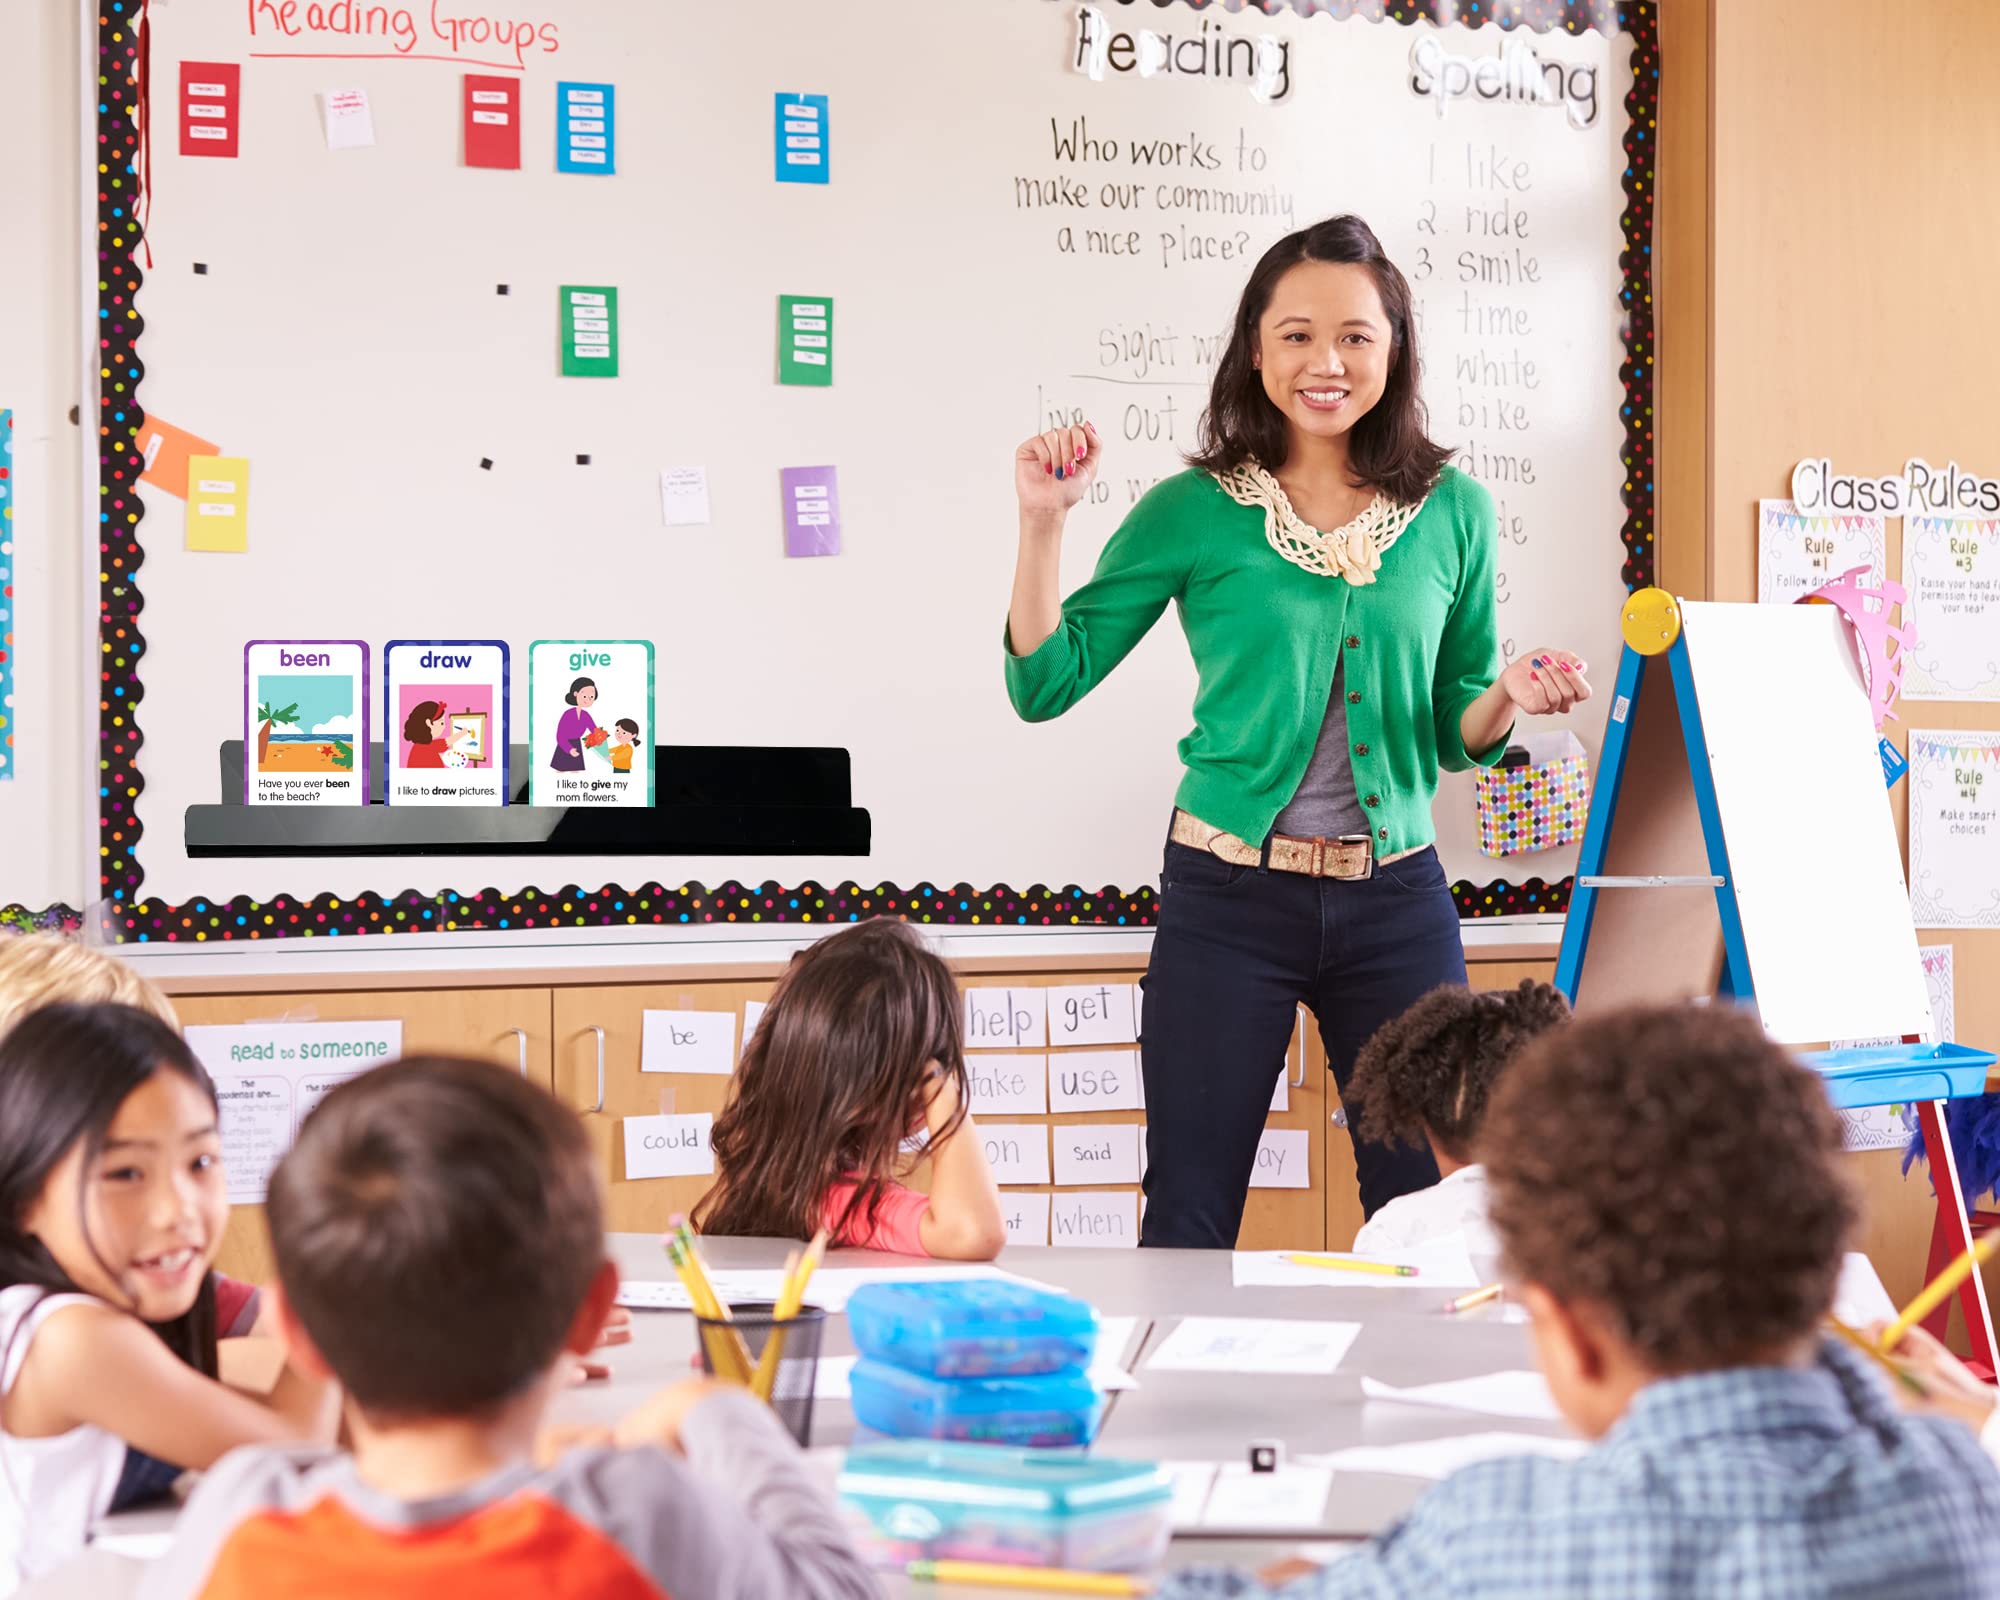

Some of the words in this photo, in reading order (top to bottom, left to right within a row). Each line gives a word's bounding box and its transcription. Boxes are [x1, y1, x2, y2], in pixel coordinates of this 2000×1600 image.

[431, 0, 559, 65] Groups
[1051, 115, 1118, 162] Who
[1131, 132, 1222, 170] works
[1236, 127, 1267, 172] to
[1466, 143, 1532, 192] like
[1014, 175, 1089, 209] make
[1100, 183, 1145, 210] our
[1156, 183, 1295, 232] community
[1466, 198, 1529, 239] ride
[1057, 226, 1076, 254] a
[1086, 228, 1141, 255] nice
[1159, 224, 1250, 268] place?
[1456, 290, 1532, 336] time
[1456, 349, 1541, 389] white
[1458, 387, 1530, 431] bike
[1458, 440, 1536, 485] dime
[1798, 461, 1899, 512] Class
[1908, 462, 2000, 512] Rules
[1805, 537, 1834, 554] Rule
[1950, 538, 1978, 555] Rule
[1776, 574, 1808, 588] Follow
[1921, 577, 1945, 588] Raise
[1948, 580, 1966, 591] your
[1969, 580, 1990, 590] hand
[1921, 591, 1966, 602] permission
[1969, 591, 1978, 601] to
[1981, 592, 2000, 602] leav
[1942, 605, 1960, 615] your
[1964, 603, 1985, 614] seat
[280, 649, 331, 667] been
[420, 651, 472, 668] draw
[569, 649, 611, 671] give
[258, 779, 282, 789] Have
[284, 781, 302, 792] you
[303, 781, 324, 789] ever
[325, 779, 350, 789] been
[562, 780, 578, 789] like
[580, 781, 589, 789] to
[591, 780, 611, 792] give
[613, 783, 628, 793] my
[1955, 768, 1984, 785] Rule
[258, 792, 268, 801] to
[270, 792, 284, 801] the
[287, 792, 321, 801] beach?
[402, 787, 419, 796] like
[420, 788, 430, 796] to
[431, 787, 457, 796] draw
[459, 787, 497, 799] pictures.
[582, 792, 618, 802] flowers.
[1940, 809, 1965, 821] Make
[1968, 810, 1996, 821] smart
[1949, 823, 1986, 835] choices
[969, 990, 1033, 1046] help
[1064, 986, 1111, 1033] get
[670, 1025, 698, 1046] be
[231, 1042, 274, 1062] Read
[280, 1049, 295, 1059] to
[299, 1041, 388, 1060] someone
[967, 1067, 1027, 1098] take
[1061, 1070, 1120, 1096] use
[643, 1127, 698, 1149] could
[1257, 1147, 1286, 1176] ay
[1006, 1213, 1023, 1230] nt
